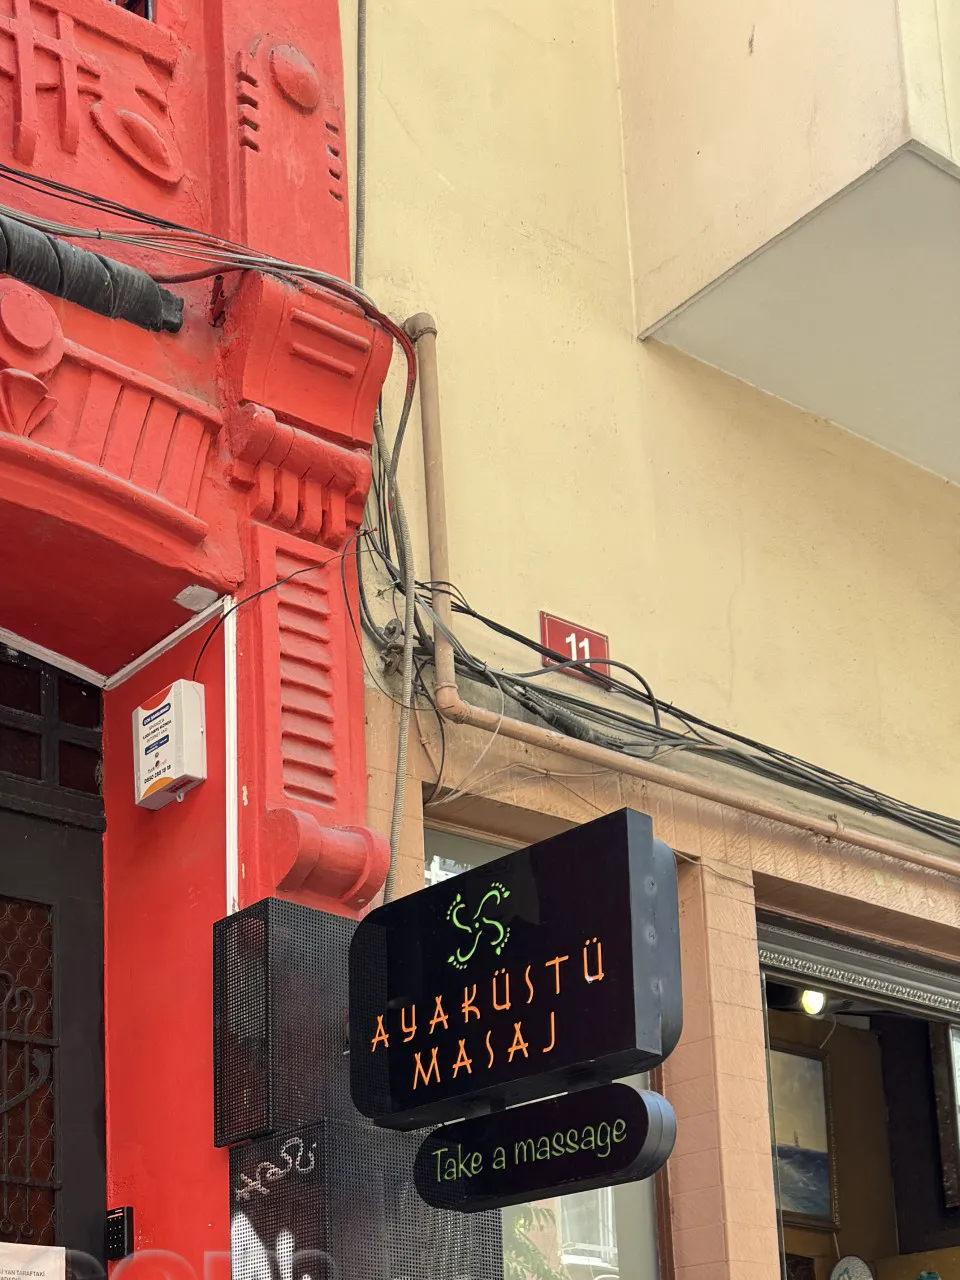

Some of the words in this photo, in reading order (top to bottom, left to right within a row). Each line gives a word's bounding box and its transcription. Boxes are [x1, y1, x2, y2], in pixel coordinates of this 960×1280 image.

[565, 632, 591, 668] 11
[371, 938, 604, 1052] AYAKÜSTÜ
[412, 1012, 556, 1090] MASAJ
[432, 1147, 484, 1183] Take
[492, 1147, 506, 1170] a
[514, 1117, 628, 1166] massage
